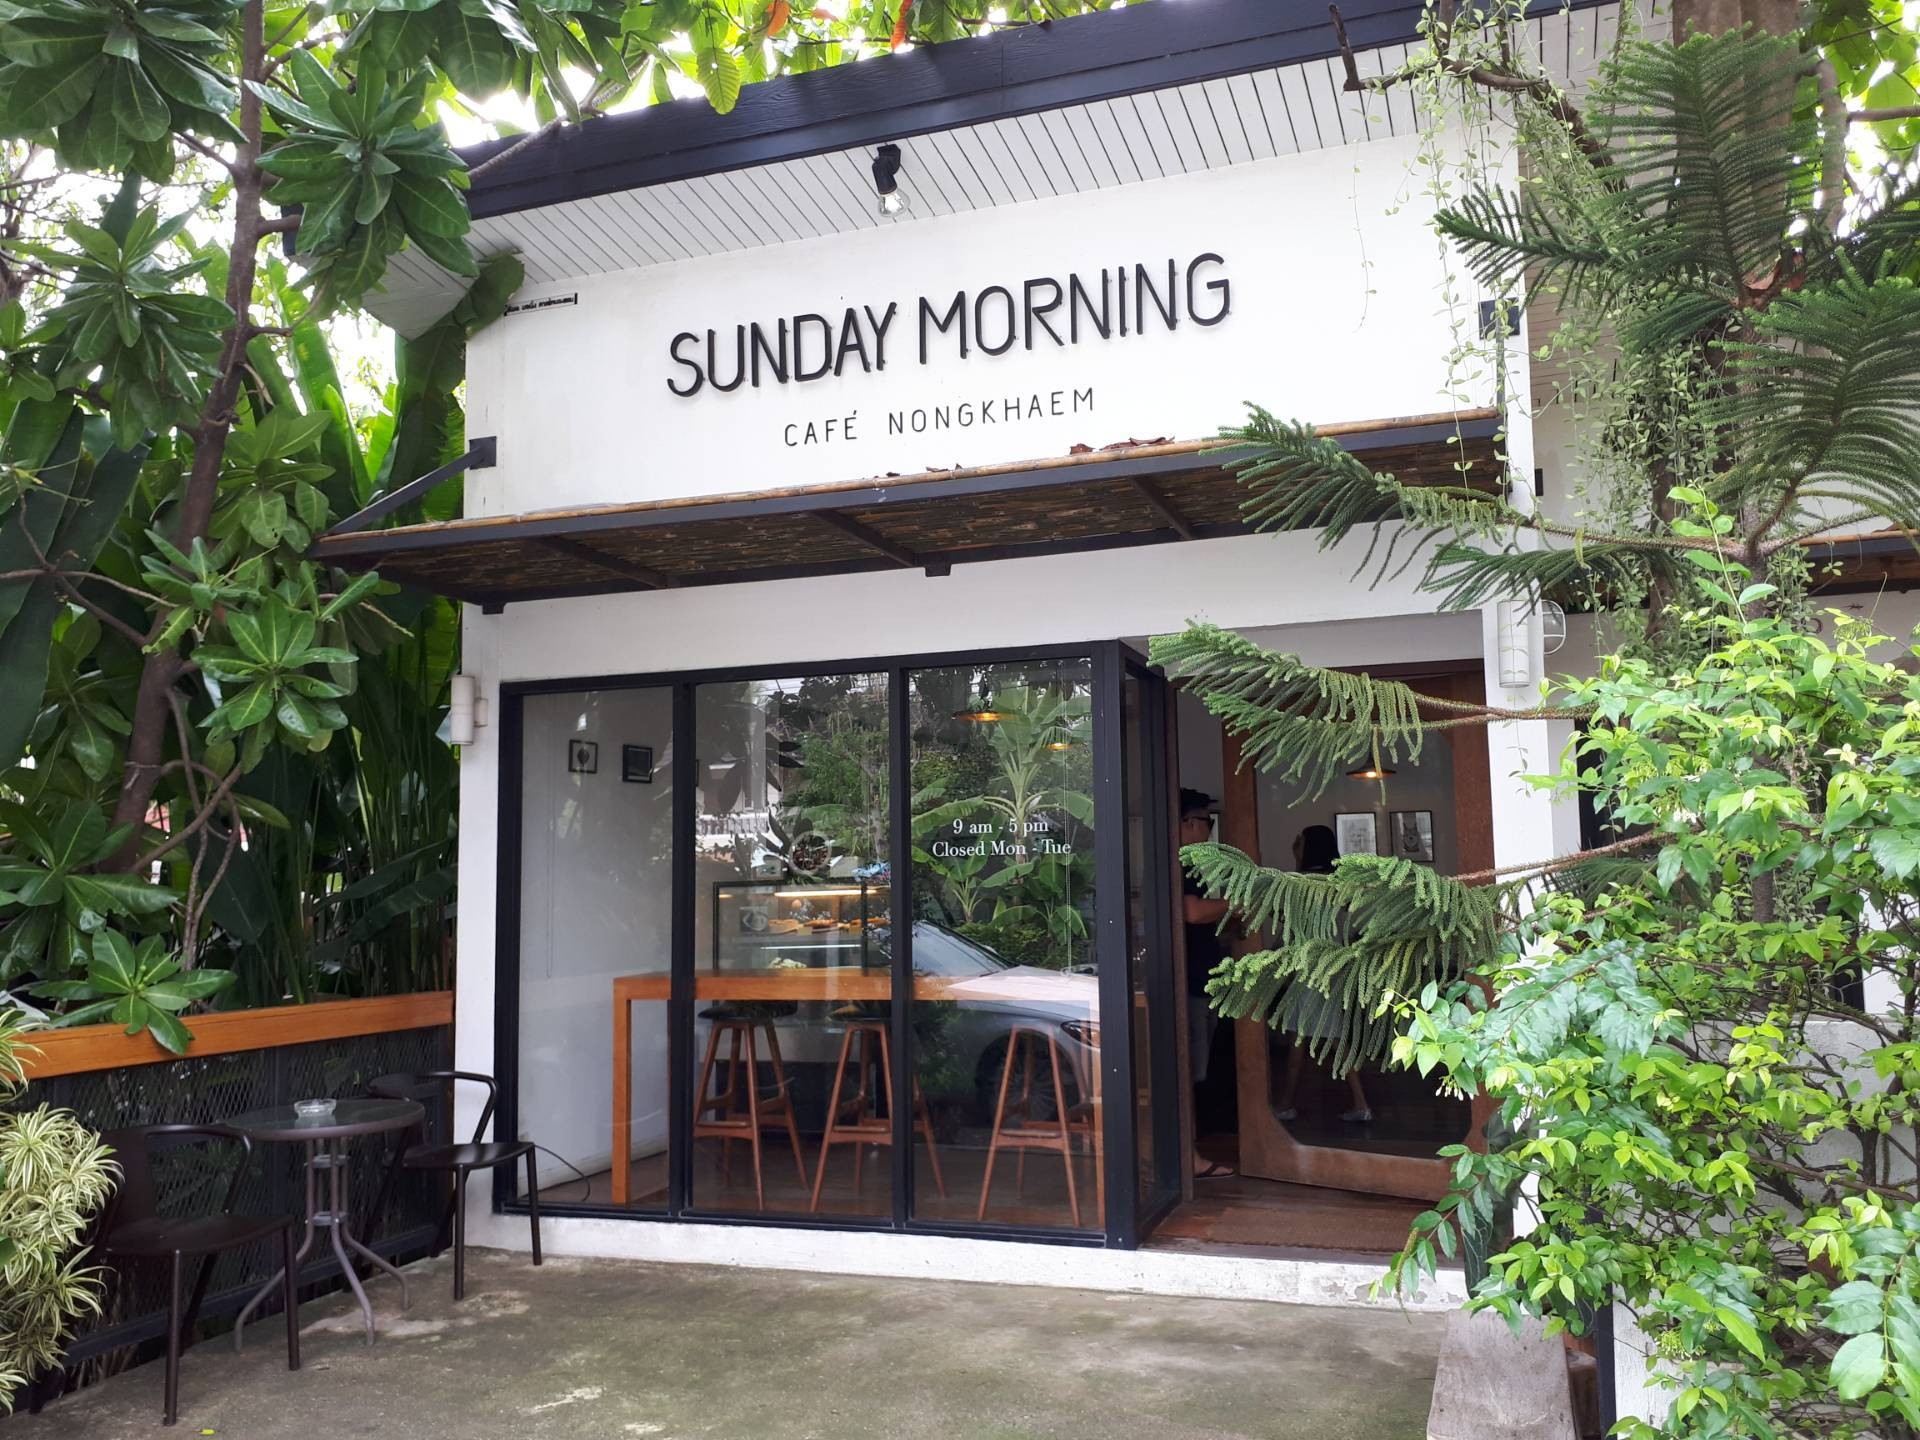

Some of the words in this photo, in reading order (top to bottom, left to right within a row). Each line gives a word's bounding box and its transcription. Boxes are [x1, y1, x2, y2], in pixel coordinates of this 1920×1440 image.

[667, 302, 898, 398] SUNDAY
[919, 253, 1230, 364] MORNING
[784, 410, 858, 447] CAFÉ
[888, 388, 1094, 434] NONGKHAEM
[953, 819, 963, 834] 9
[969, 823, 992, 834] am
[1009, 818, 1018, 834] 5
[1023, 821, 1048, 838] pm
[932, 841, 985, 858] Closed
[990, 841, 1026, 856] Mon
[1042, 838, 1072, 854] Tue
